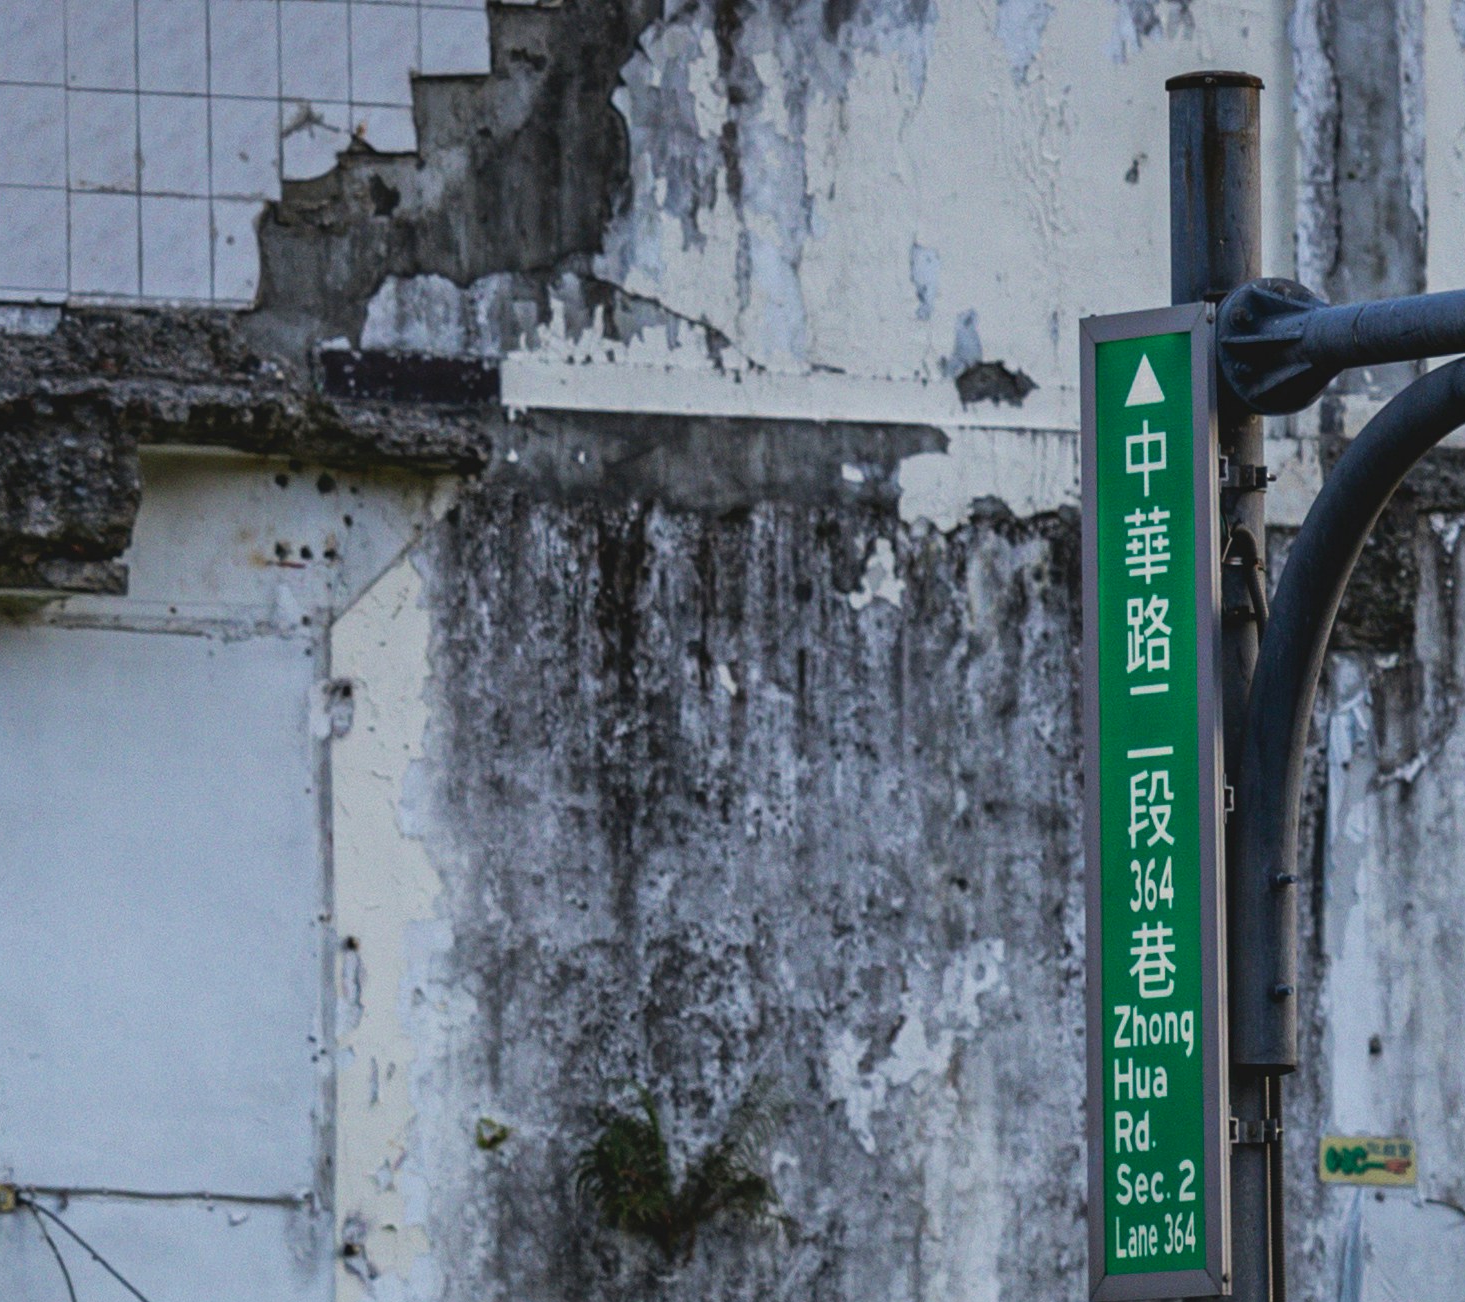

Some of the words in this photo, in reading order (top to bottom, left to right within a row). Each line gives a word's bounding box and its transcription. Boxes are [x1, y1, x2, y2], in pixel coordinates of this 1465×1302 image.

[1113, 1005, 1196, 1058] Zhong
[1113, 1058, 1169, 1101] Hua
[1114, 1110, 1157, 1154] Rd.
[1115, 1162, 1172, 1206] Sec.
[1178, 1158, 1197, 1203] 2
[1114, 1215, 1159, 1259] Lane
[1164, 1211, 1197, 1255] 364
